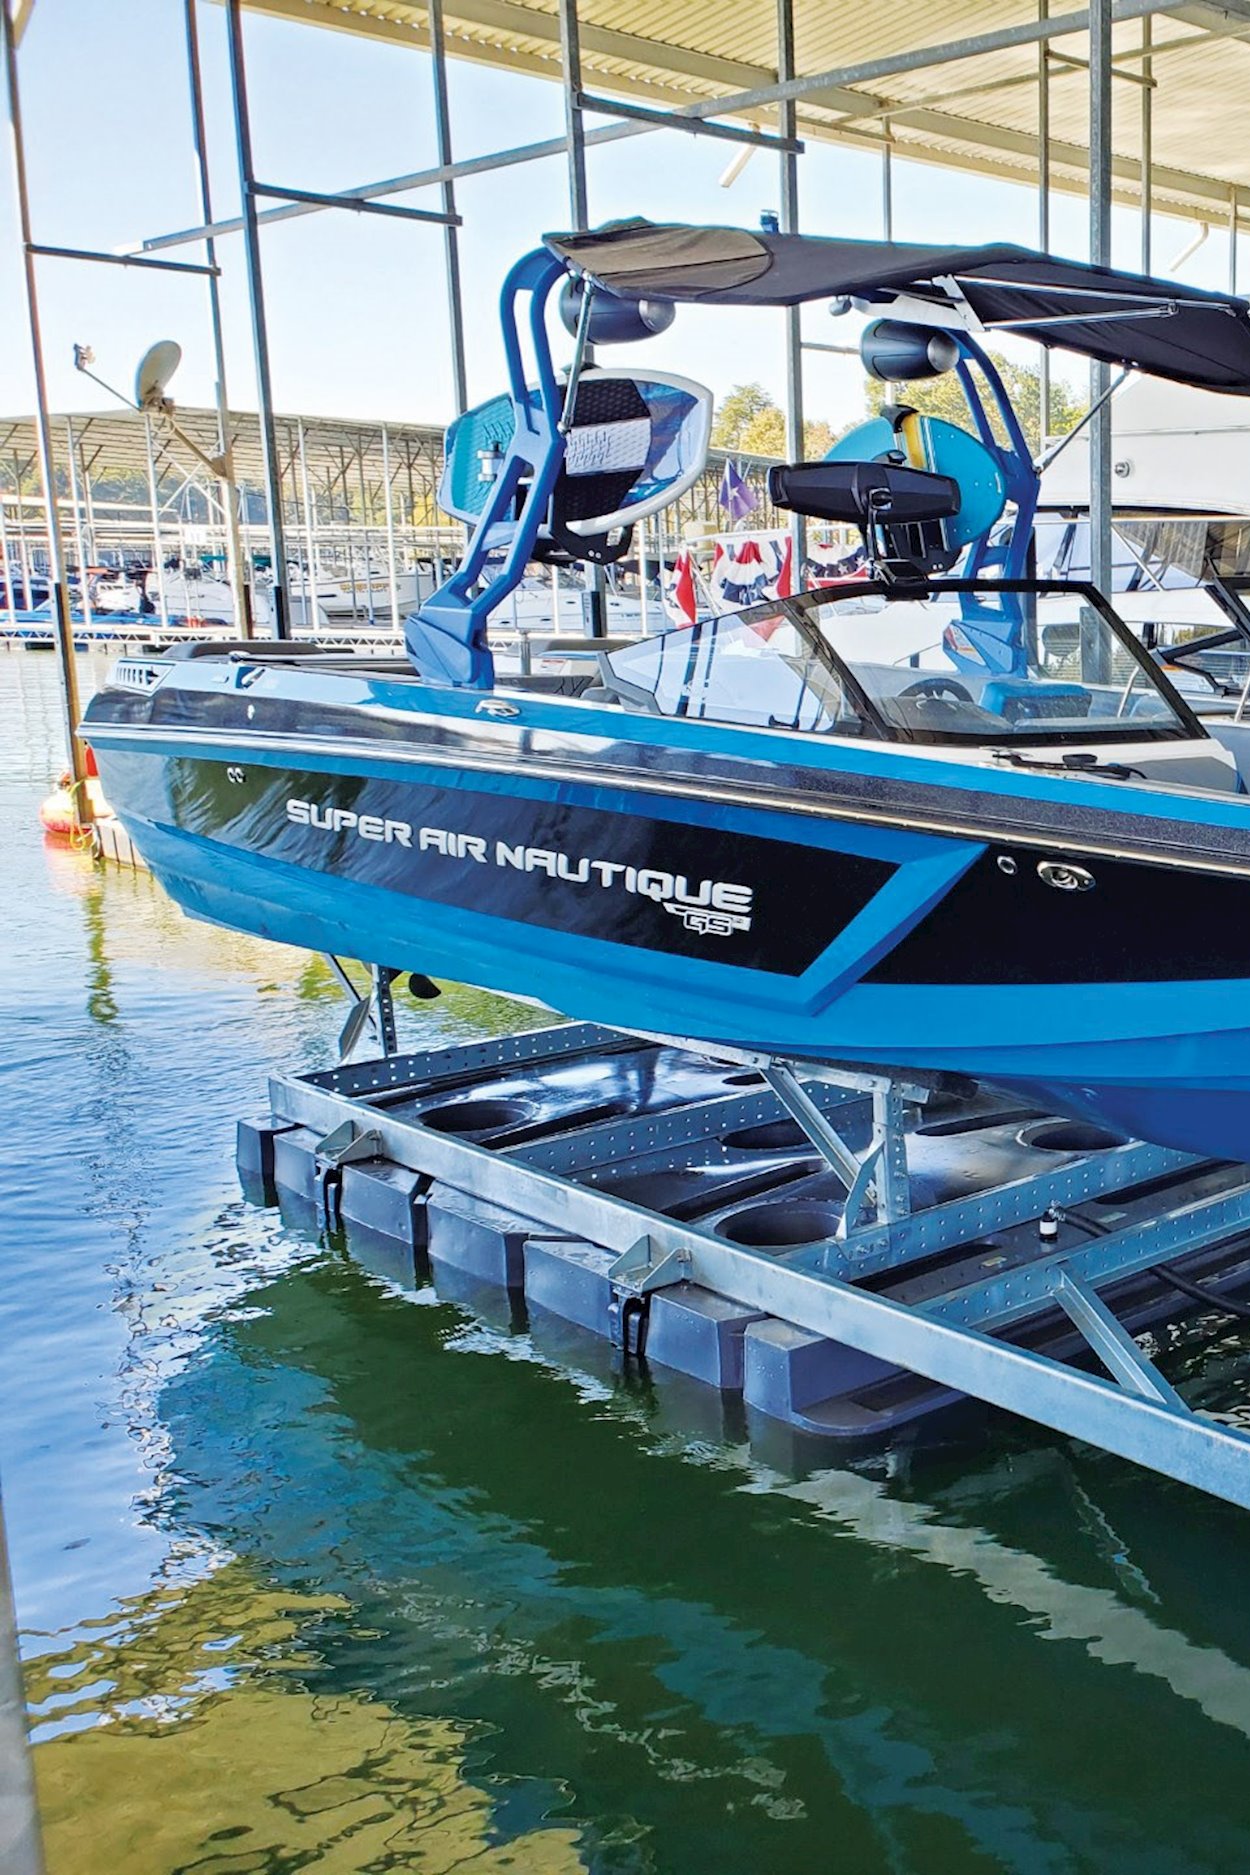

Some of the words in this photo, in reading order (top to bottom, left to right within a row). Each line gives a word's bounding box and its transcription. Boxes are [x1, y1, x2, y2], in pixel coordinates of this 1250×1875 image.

[286, 799, 412, 849] SUPER
[419, 827, 487, 864] AIR
[496, 841, 753, 914] NAUTIQUE
